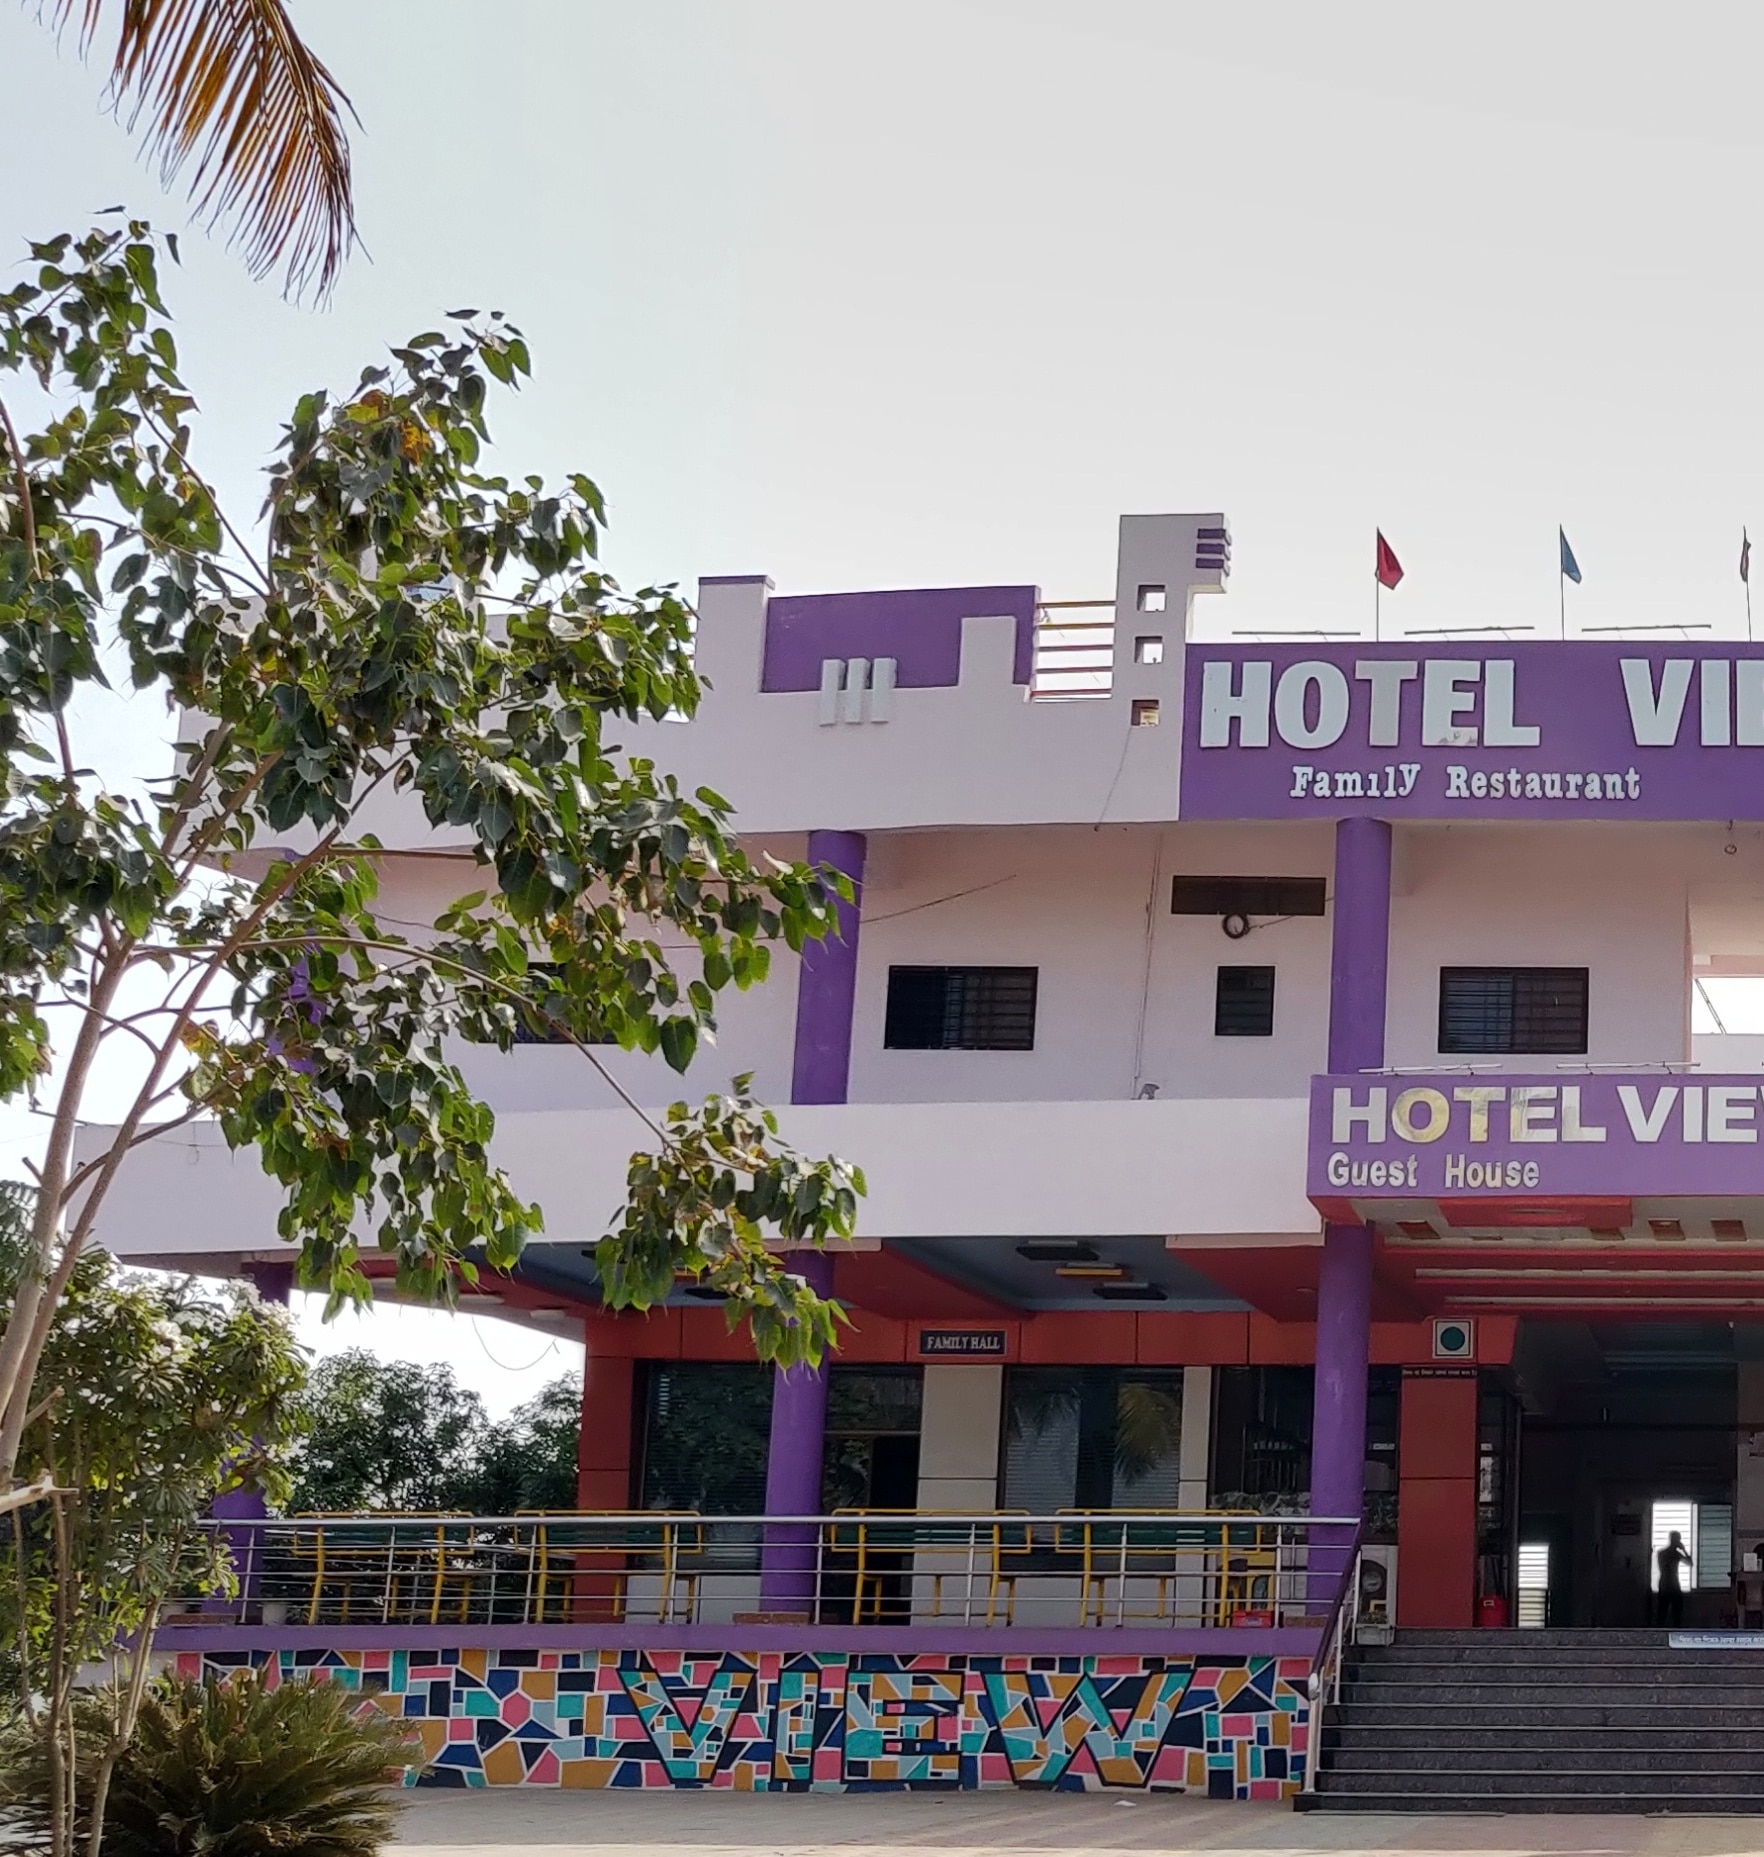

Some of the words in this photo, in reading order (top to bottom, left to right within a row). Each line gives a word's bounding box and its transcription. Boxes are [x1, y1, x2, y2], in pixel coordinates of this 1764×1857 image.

[1199, 659, 1542, 749] HOTEL
[1289, 763, 1421, 798] Family
[1445, 765, 1641, 800] Restaurant
[1331, 1085, 1608, 1144] HOTEL
[1327, 1151, 1418, 1188] Guest
[1445, 1153, 1541, 1188] House
[927, 1336, 968, 1350] FAMILY
[970, 1336, 1001, 1350] HALL
[615, 1668, 1198, 1788] VIEW
